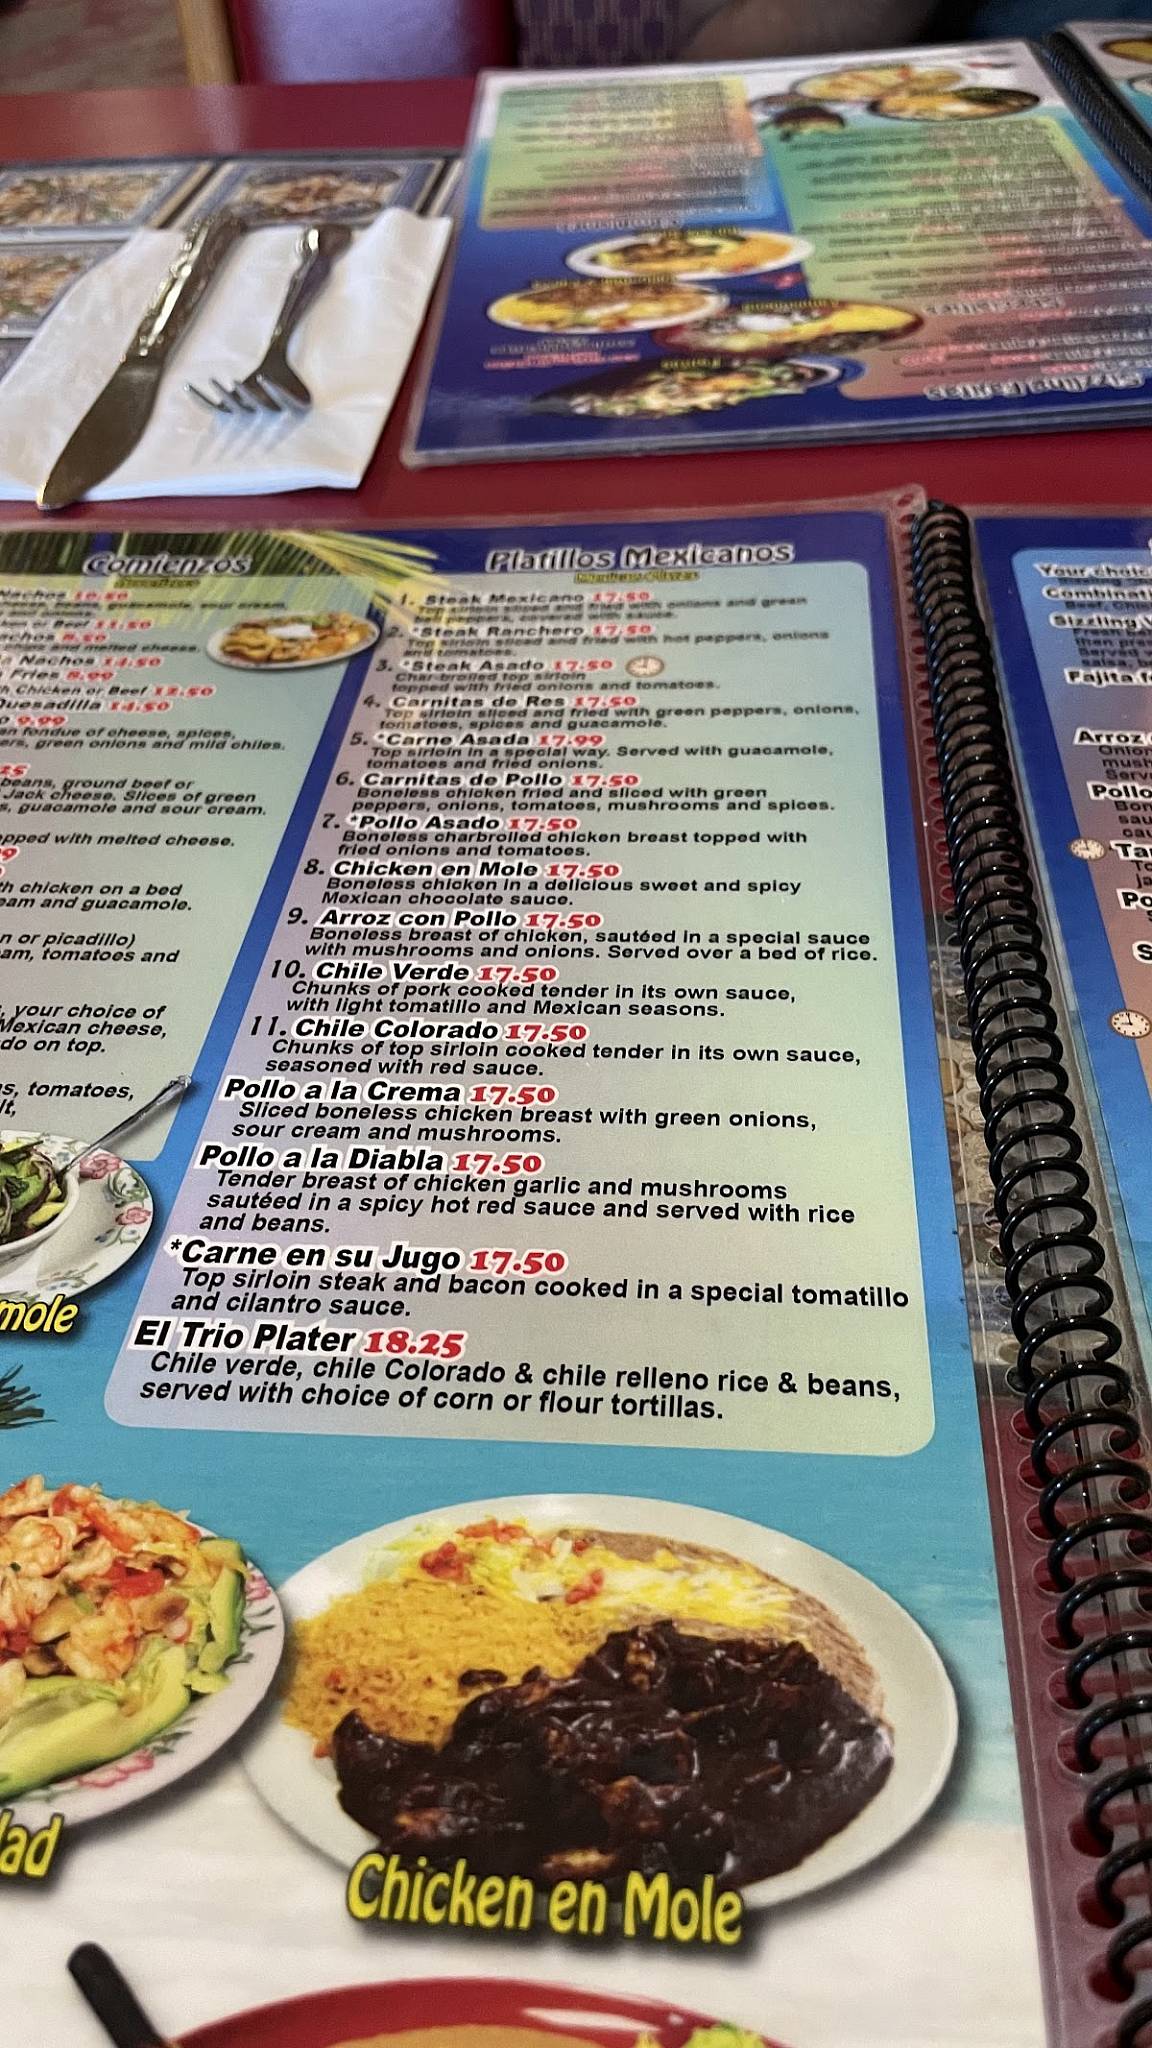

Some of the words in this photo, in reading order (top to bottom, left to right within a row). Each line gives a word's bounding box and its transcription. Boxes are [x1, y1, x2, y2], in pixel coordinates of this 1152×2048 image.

[84, 553, 250, 575] Comienzos
[489, 548, 612, 571] Platillos
[624, 545, 793, 566] Mexicanos
[426, 595, 480, 605] Steak
[488, 594, 584, 603] Mexicano
[487, 626, 584, 636] Ranchero
[376, 659, 393, 671] 3.
[480, 659, 544, 671] Asado
[555, 660, 612, 671] 17.50
[1069, 671, 1134, 685] Fajita
[15, 684, 81, 695] Chicken
[86, 688, 104, 696] or
[108, 686, 148, 696] Beef
[364, 696, 380, 707] 4.
[393, 697, 483, 707] Carnitas
[492, 696, 517, 707] de
[526, 696, 564, 707] Res
[576, 697, 635, 707] 17.50
[379, 720, 462, 732] tomatoes,
[469, 720, 524, 732] spices
[530, 719, 562, 729] and
[567, 719, 666, 731] guacamole.
[35, 740, 83, 749] green
[89, 739, 146, 748] onions
[152, 740, 185, 749] and
[189, 739, 227, 749] mild
[351, 733, 368, 745] 5.
[460, 733, 529, 745] Asada
[540, 736, 602, 746] 17.99
[1078, 731, 1144, 744] Arroz
[336, 772, 354, 785] 6.
[365, 773, 460, 786] Carnitas
[470, 774, 497, 786] de
[506, 773, 562, 785] Pollo
[574, 775, 638, 787] 17.50
[18, 803, 116, 814] guacamole
[122, 803, 156, 813] and
[161, 806, 202, 814] sour
[207, 806, 265, 815] cream.
[351, 802, 430, 816] peppers,
[437, 800, 504, 813] onions,
[512, 800, 600, 812] tomatoes,
[608, 800, 719, 810] mushrooms
[727, 800, 760, 810] and
[768, 800, 834, 813] spices.
[323, 814, 340, 828] 7.
[425, 816, 499, 829] Asado
[511, 817, 576, 831] 17.50
[304, 859, 324, 875] 8.
[335, 861, 432, 875] Chicken
[441, 865, 470, 876] en
[480, 862, 537, 876] Mole
[550, 864, 619, 879] 17.50
[20, 882, 93, 894] chicken
[100, 886, 123, 894] on
[129, 886, 140, 895] a
[146, 884, 183, 896] bed
[40, 897, 78, 908] and
[81, 898, 191, 911] guacamole.
[322, 891, 401, 904] Mexican
[409, 892, 503, 905] chocolate
[510, 895, 573, 905] sauce.
[288, 908, 308, 925] 9.
[320, 910, 390, 925] Arroz
[399, 914, 445, 926] con
[454, 911, 516, 926] Pollo
[525, 913, 601, 929] 17.50
[272, 960, 305, 978] 10.
[317, 962, 382, 979] Chile
[394, 963, 469, 980] Verde
[479, 967, 555, 983] 17.50
[15, 1006, 63, 1023] your
[67, 1004, 136, 1018] choice
[143, 1006, 166, 1019] of
[287, 997, 329, 1012] with
[336, 997, 383, 1015] light
[389, 999, 480, 1013] tomatillo
[487, 1000, 526, 1014] and
[534, 1000, 620, 1015] Mexican
[628, 1004, 724, 1016] seasons.
[88, 1021, 166, 1039] cheese,
[251, 1016, 286, 1036] 11.
[296, 1019, 364, 1037] Chile
[375, 1020, 498, 1039] Colorado
[506, 1024, 586, 1042] 17.50
[225, 1079, 295, 1098] Pollo
[305, 1085, 322, 1099] a
[331, 1081, 358, 1099] la
[368, 1081, 460, 1101] Crema
[474, 1087, 555, 1105] 17.50
[200, 1145, 274, 1167] Pollo
[283, 1152, 301, 1167] a
[311, 1148, 338, 1168] la
[349, 1148, 443, 1170] Diabla
[456, 1154, 541, 1175] 17.50
[287, 1248, 325, 1267] en
[335, 1249, 373, 1267] su
[382, 1245, 460, 1275] Jugo
[472, 1251, 565, 1275] 17.50
[183, 1267, 225, 1292] Top
[232, 1269, 310, 1290] sirloin
[318, 1272, 387, 1292] steak
[393, 1274, 441, 1293] and
[448, 1274, 525, 1295] bacon
[535, 1278, 628, 1298] cooked
[637, 1279, 658, 1299] in
[669, 1285, 682, 1299] a
[691, 1283, 782, 1306] special
[792, 1285, 908, 1307] tomatillo
[171, 1291, 220, 1311] and
[226, 1292, 321, 1313] cilantro
[329, 1299, 410, 1316] sauce.
[134, 1320, 171, 1346] El
[183, 1322, 243, 1348] Trio
[253, 1324, 356, 1351] Plater
[367, 1330, 464, 1359] 18.25
[140, 1380, 232, 1401] served
[239, 1381, 293, 1403] with
[302, 1383, 389, 1406] choice
[399, 1386, 428, 1408] of
[434, 1392, 493, 1410] corn
[504, 1394, 532, 1411] or
[539, 1390, 603, 1414] flour
[611, 1393, 722, 1419] tortillas.
[347, 1852, 534, 1930] Chicken
[549, 1879, 607, 1935] en
[623, 1870, 742, 1944] Mole
